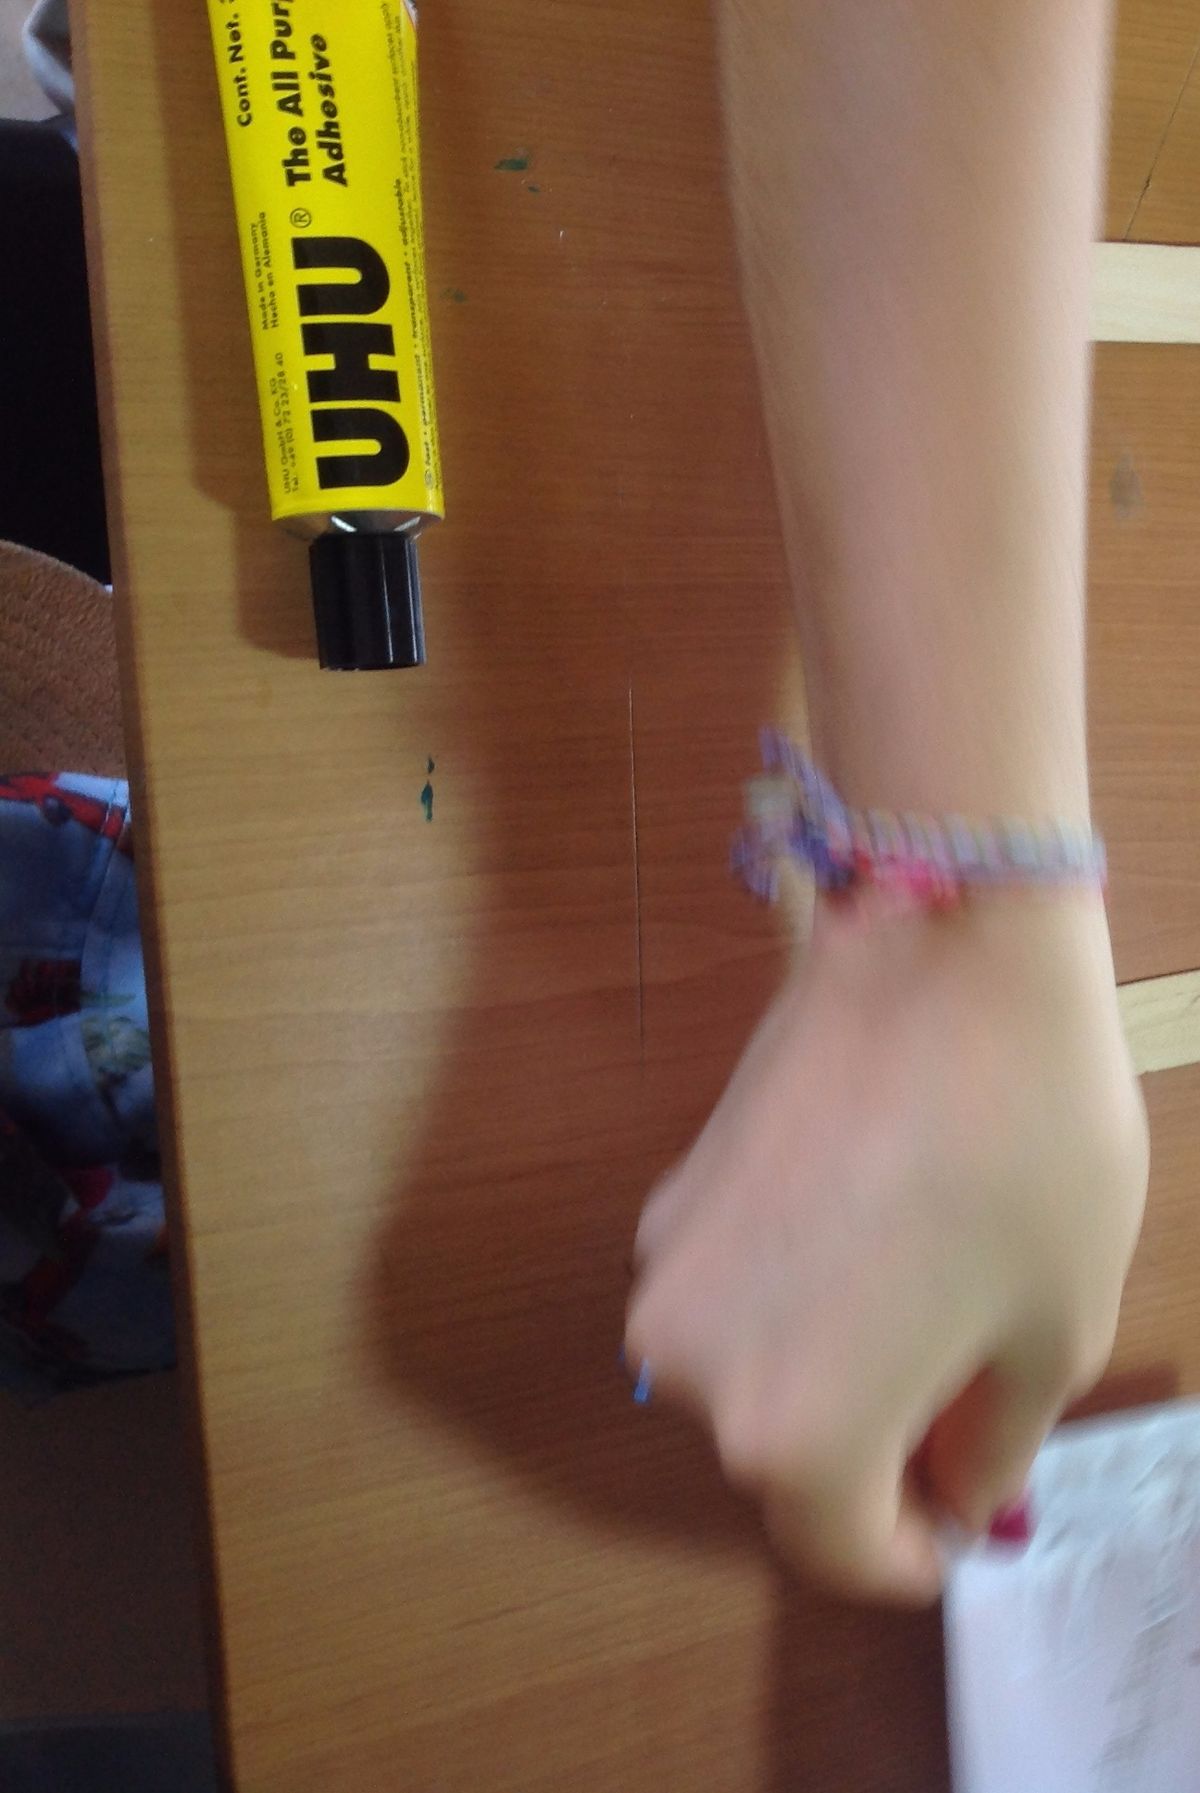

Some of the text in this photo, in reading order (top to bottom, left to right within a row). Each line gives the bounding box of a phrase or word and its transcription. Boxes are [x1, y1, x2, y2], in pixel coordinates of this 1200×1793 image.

[225, 13, 244, 63] Net.
[233, 67, 252, 128] Cont.
[270, 71, 304, 117] All
[309, 34, 348, 187] Adhesive
[282, 126, 311, 187] The
[251, 223, 262, 278] Germany
[258, 212, 280, 328] Hecho en Alemania
[258, 296, 269, 330] Made
[291, 236, 410, 490] UHU
